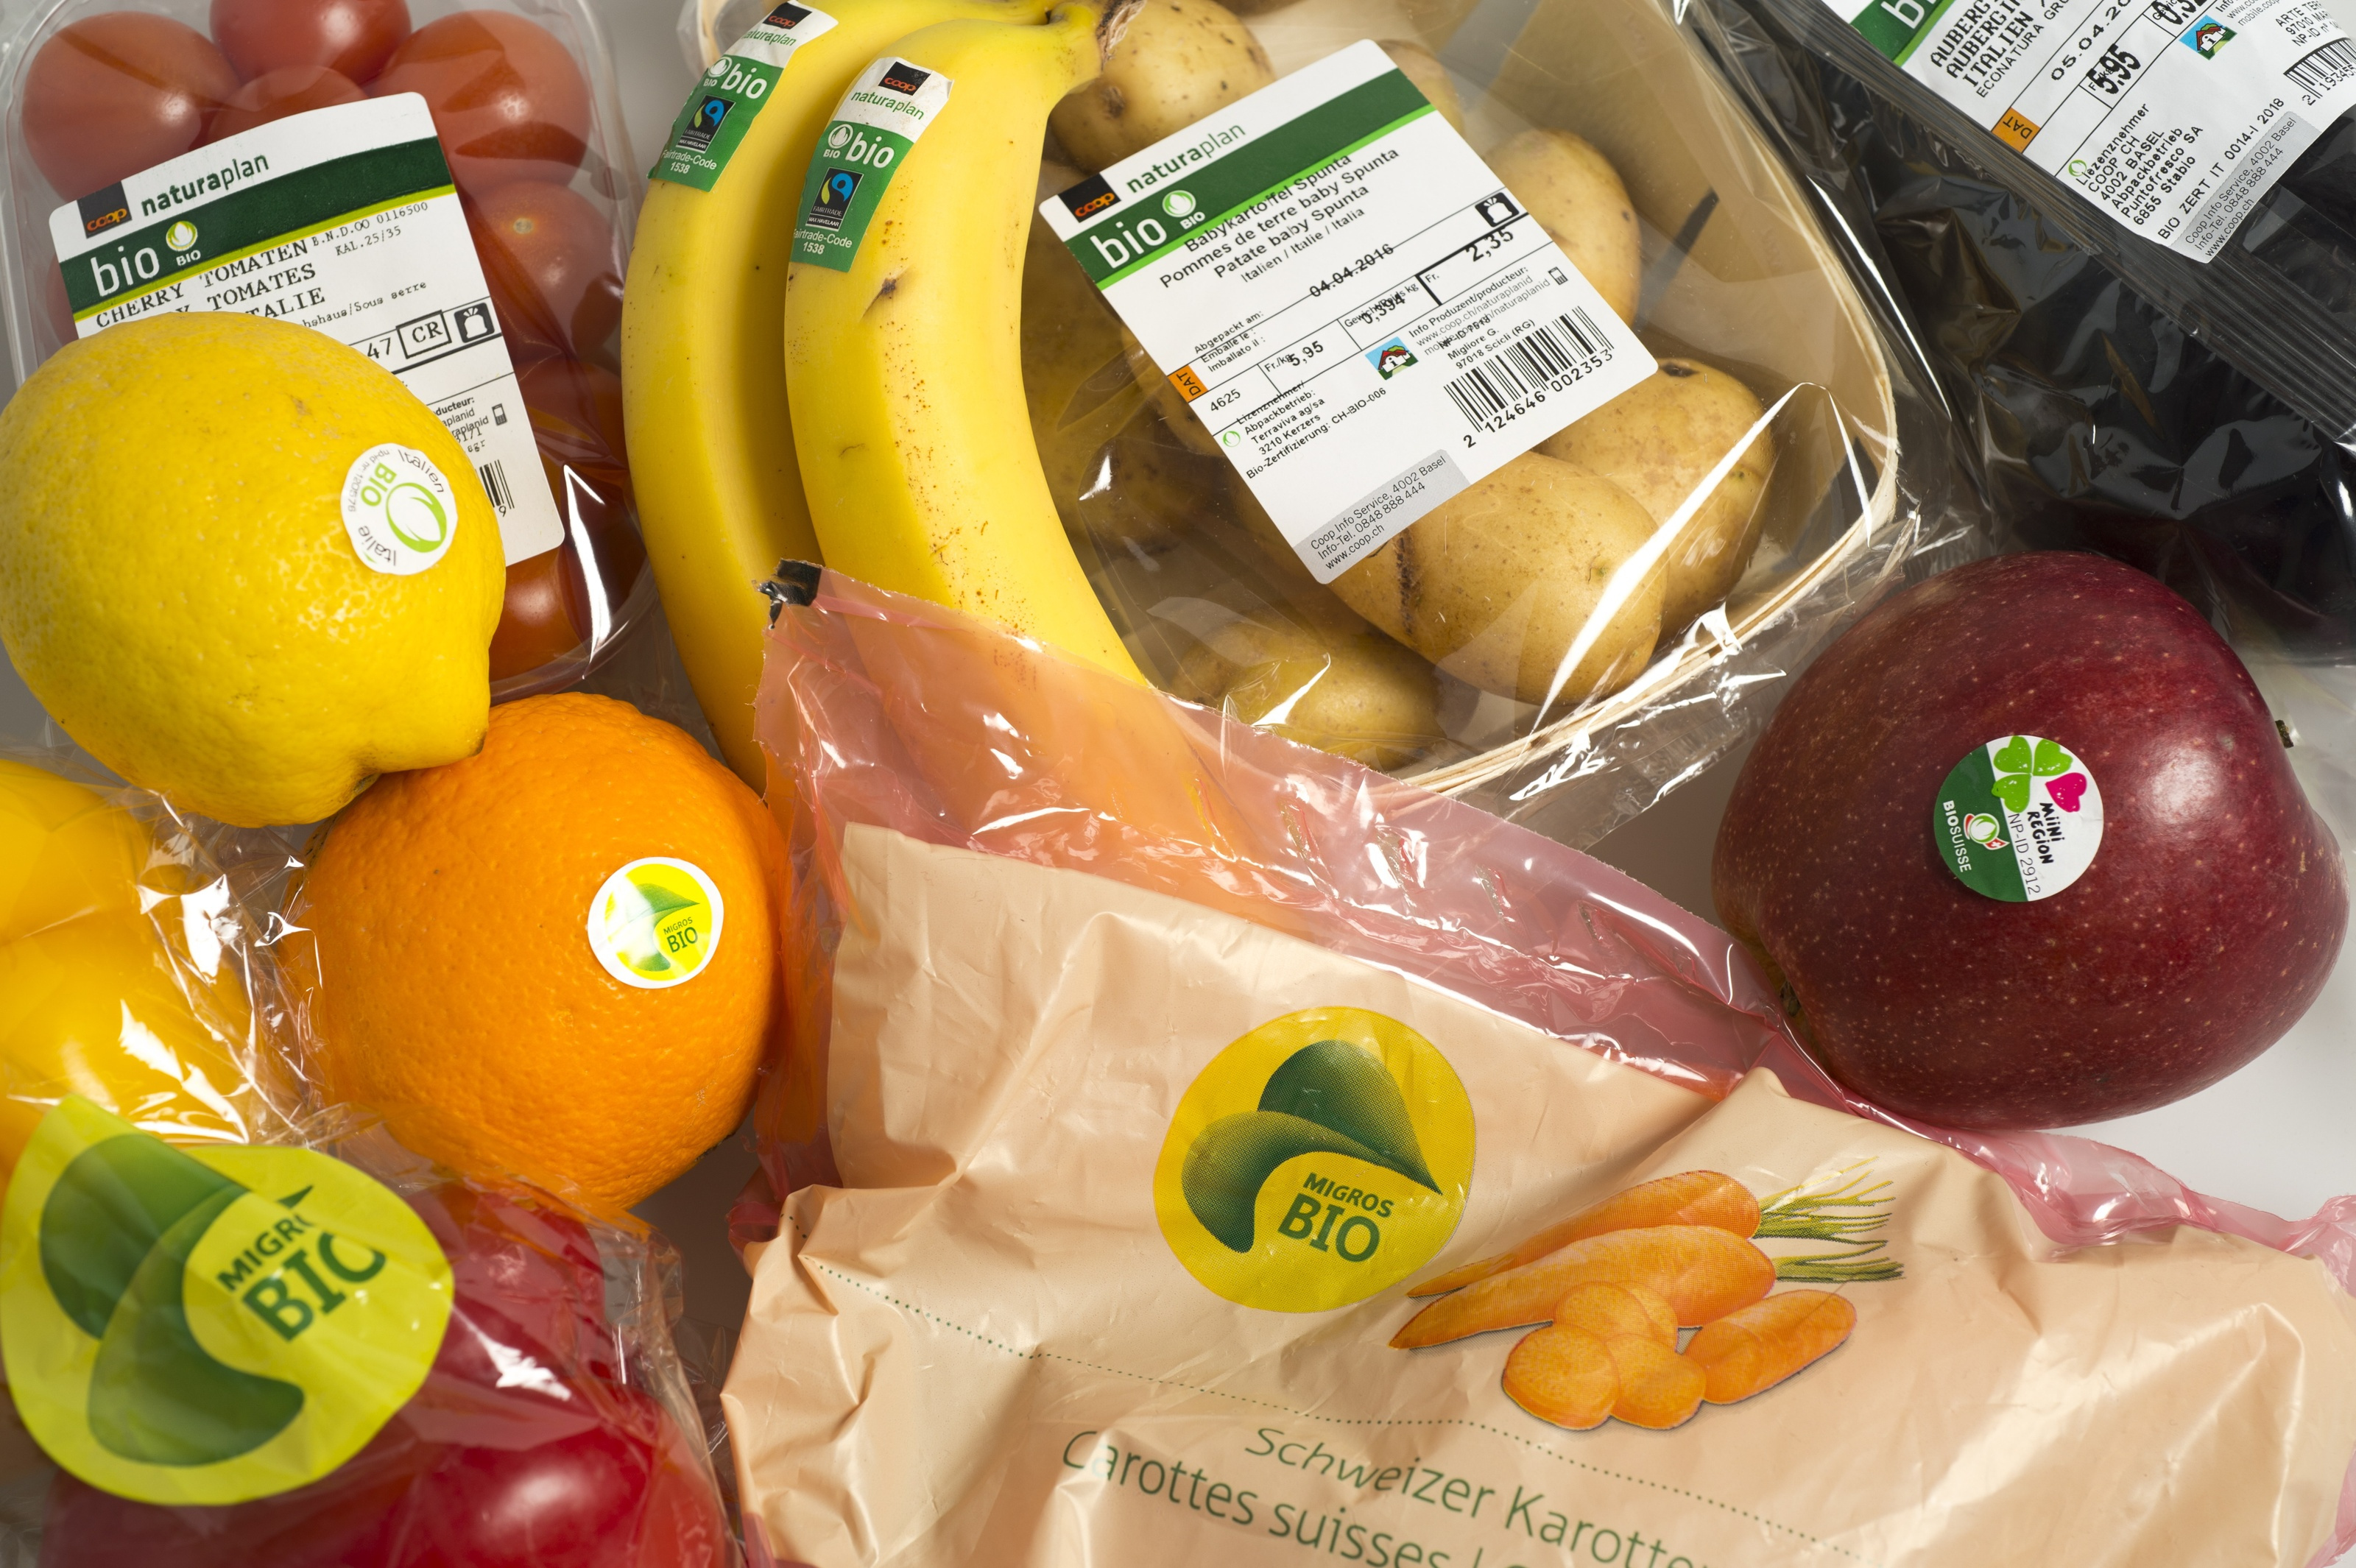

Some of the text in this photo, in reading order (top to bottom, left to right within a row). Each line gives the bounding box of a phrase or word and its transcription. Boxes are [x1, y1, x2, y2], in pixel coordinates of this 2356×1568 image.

[742, 29, 797, 46] aturaplan
[769, 15, 796, 28] coop
[1930, 0, 1998, 67] AUBERG
[2275, 7, 2304, 27] ARTE
[2285, 16, 2314, 35] 97010
[2291, 27, 2321, 46] NP-ID
[1963, 10, 2034, 88] ITALIEN
[1976, 23, 2045, 98] ECONATURA
[703, 63, 767, 99] BIO bio
[884, 77, 917, 92] coop
[2302, 94, 2316, 106] 2
[851, 91, 925, 120] naturaplan
[2003, 116, 2033, 139] DAT
[685, 130, 711, 140] FAIRTRADE
[687, 140, 707, 149] HAVELAAR
[823, 131, 895, 168] BIO bio
[2075, 103, 2149, 186] Liezenznehmer
[670, 162, 690, 174] 1538
[1126, 122, 1246, 194] naturaplan
[2087, 136, 2140, 193] COOP CH
[2101, 130, 2165, 202] 4002 BASEL
[2111, 127, 2183, 210] Abpackbetrieb
[2120, 125, 2204, 218] Puntofresco SA
[2157, 216, 2181, 239] BIO
[2179, 178, 2211, 214] ZERT
[2209, 162, 2225, 177] IT
[2257, 98, 2285, 124] 2018
[2185, 117, 2297, 244] Coop Info Service, 4002 Basel
[141, 155, 269, 216] naturaplan
[1074, 191, 1115, 219] coop
[1183, 155, 1352, 253] Babykartoffel Spunta
[2133, 156, 2195, 225] 6855 Stabio
[2194, 147, 2284, 250] Info-Tel. 0848 888 444
[86, 208, 127, 232] coop
[812, 205, 843, 217] FAIRTRADE
[817, 217, 839, 227] HAVELAAR
[1159, 148, 1400, 289] Pommes de terre baby Spunta
[1179, 211, 1206, 230] BIO
[1213, 186, 1370, 278] Patate baby Spunta
[2205, 198, 2254, 257] www.coop.ch
[176, 250, 201, 266] BIO
[335, 225, 401, 256] KAL.25/35
[803, 241, 825, 255] 1538
[1090, 218, 1167, 269] bio
[1241, 208, 1366, 283] Italien Italie Italia
[1465, 227, 1514, 262] 2,35
[91, 245, 160, 297] bio
[96, 283, 184, 328] CHERRY
[199, 239, 308, 289] TOMATEN
[376, 202, 428, 225] 0116500
[207, 262, 317, 311] TOMATES
[1309, 244, 1394, 297] 04.04.2016
[1425, 273, 1440, 283] Fr.
[391, 280, 426, 300] serre
[1404, 283, 1419, 293] kg
[1408, 266, 1528, 338] Info Produzent/producteur:
[412, 321, 443, 343] CR
[1194, 310, 1264, 354] Abgepackt am:
[1417, 275, 1534, 347] www.coop.ch/naturaplanid
[1207, 338, 1260, 372] Imballato il
[1239, 330, 1251, 342] le
[1289, 340, 1325, 367] 5,95
[1447, 328, 1500, 360] Migliore G.
[1456, 318, 1536, 370] 97018 Scicli (RG)
[1177, 371, 1202, 397] DAT
[1210, 388, 1241, 413] 4625
[1237, 380, 1305, 425] Lizenznehmer/
[1463, 349, 1613, 448] 2 124646 002353
[1244, 389, 1316, 435] Abpackbetrieb:
[1246, 387, 1386, 479] Bio-Zertifizierung: CH-BIO-006
[1251, 398, 1325, 445] Terraviva ag/sa
[1259, 413, 1321, 455] 3210 Kerzers
[348, 473, 364, 512] 120576
[360, 462, 398, 507] BIO
[398, 449, 444, 492] Italien
[1311, 455, 1447, 550] Coop Info Service, 4002 Basel
[1317, 481, 1425, 559] Info-Tel. 0848 888 444
[358, 526, 396, 566] Italie
[1325, 523, 1385, 570] www.coop.ch
[1943, 800, 1972, 873] BIOSUISSE
[2008, 813, 2041, 895] NP-ID 2912
[663, 917, 693, 935] MIGROS
[666, 926, 699, 953] BIO
[1302, 1173, 1395, 1219] MIGROS
[1277, 1193, 1381, 1263] BIO
[1062, 1430, 1260, 1526] Carottes
[1244, 1427, 1496, 1521] Schweizer
